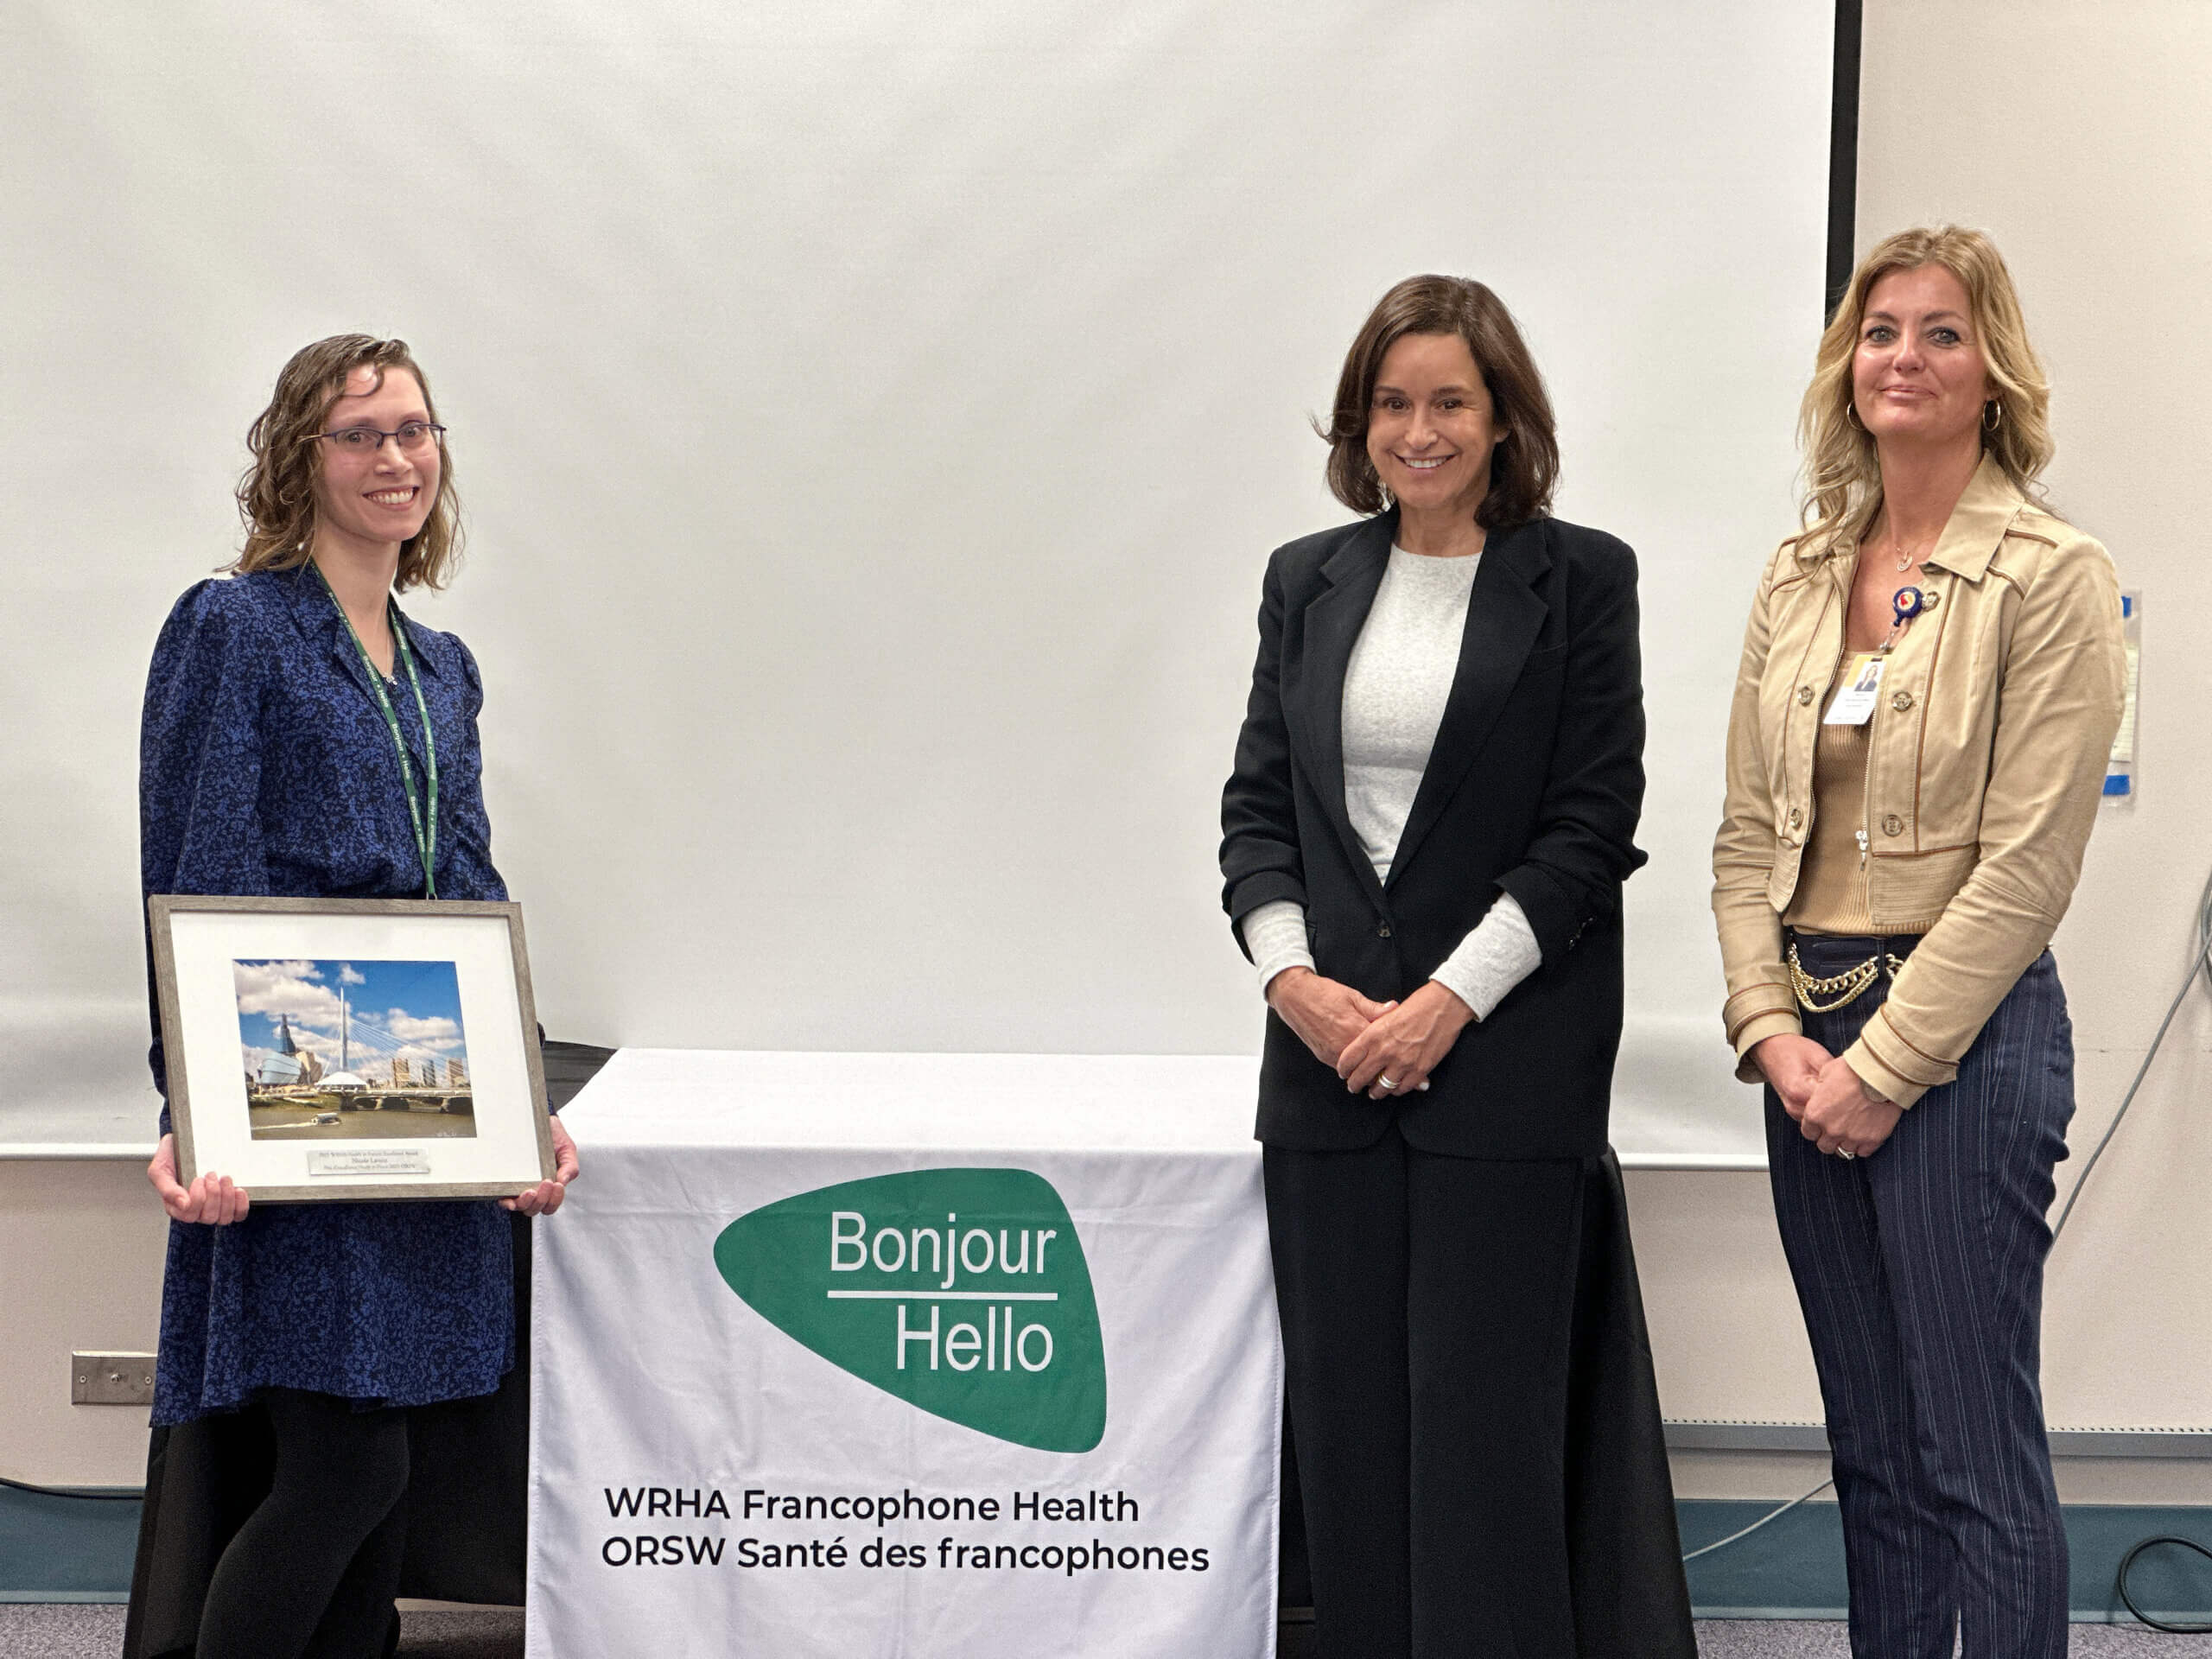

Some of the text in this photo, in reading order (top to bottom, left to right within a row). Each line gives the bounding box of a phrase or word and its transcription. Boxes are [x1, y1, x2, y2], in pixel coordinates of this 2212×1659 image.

[391, 722, 404, 752] Bonjour
[830, 1211, 1058, 1288] Bonjour
[897, 1305, 1054, 1372] Hello
[604, 1487, 1139, 1528] WRHA Francophone Health
[602, 1535, 1210, 1575] ORSW Santé des francophones
